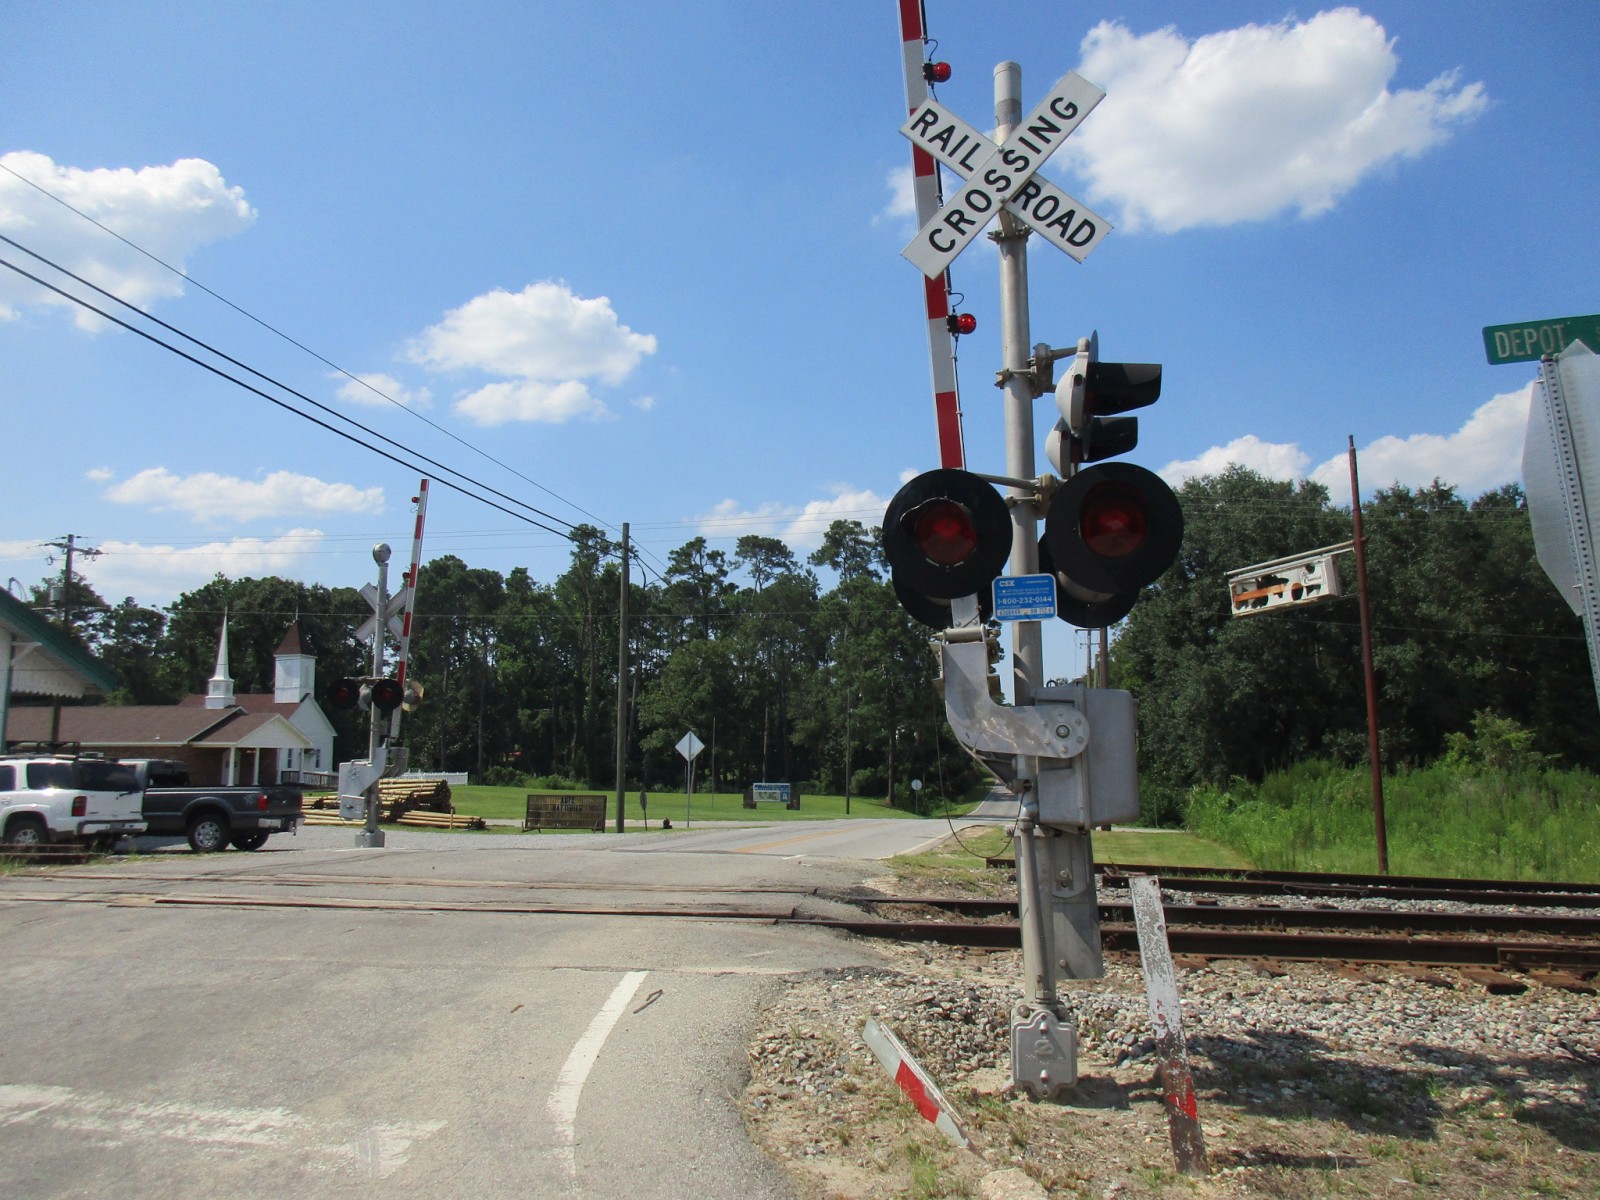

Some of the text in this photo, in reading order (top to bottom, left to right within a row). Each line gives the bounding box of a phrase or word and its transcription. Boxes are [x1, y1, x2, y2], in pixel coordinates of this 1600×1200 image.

[909, 107, 981, 173] RAIL
[928, 97, 1078, 253] CROSSING
[1011, 180, 1096, 247] ROAD
[1494, 324, 1565, 358] DEPOT
[998, 595, 1052, 605] 1-800-232-0144
